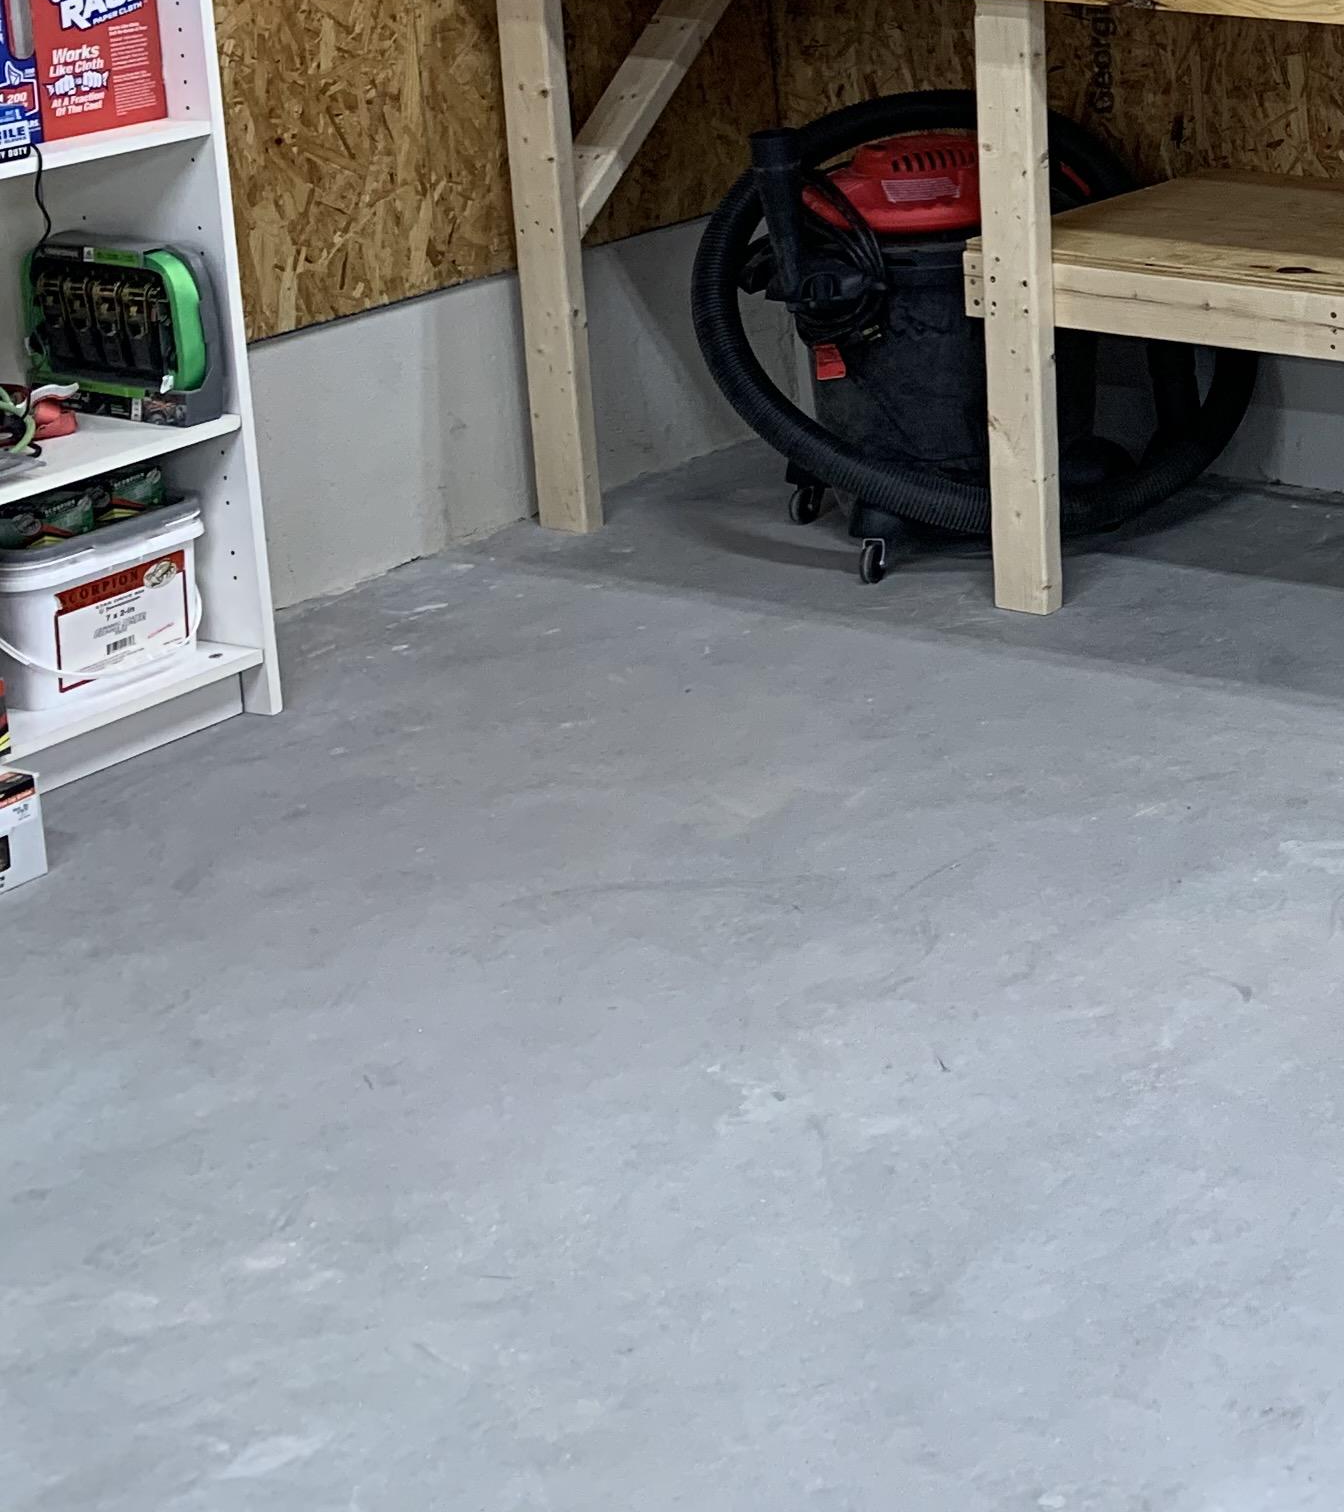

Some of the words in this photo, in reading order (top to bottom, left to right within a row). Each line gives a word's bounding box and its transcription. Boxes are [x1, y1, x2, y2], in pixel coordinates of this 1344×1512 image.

[52, 44, 101, 65] Works
[49, 63, 74, 78] Like
[75, 57, 105, 74] Cloth
[7, 92, 28, 105] 200
